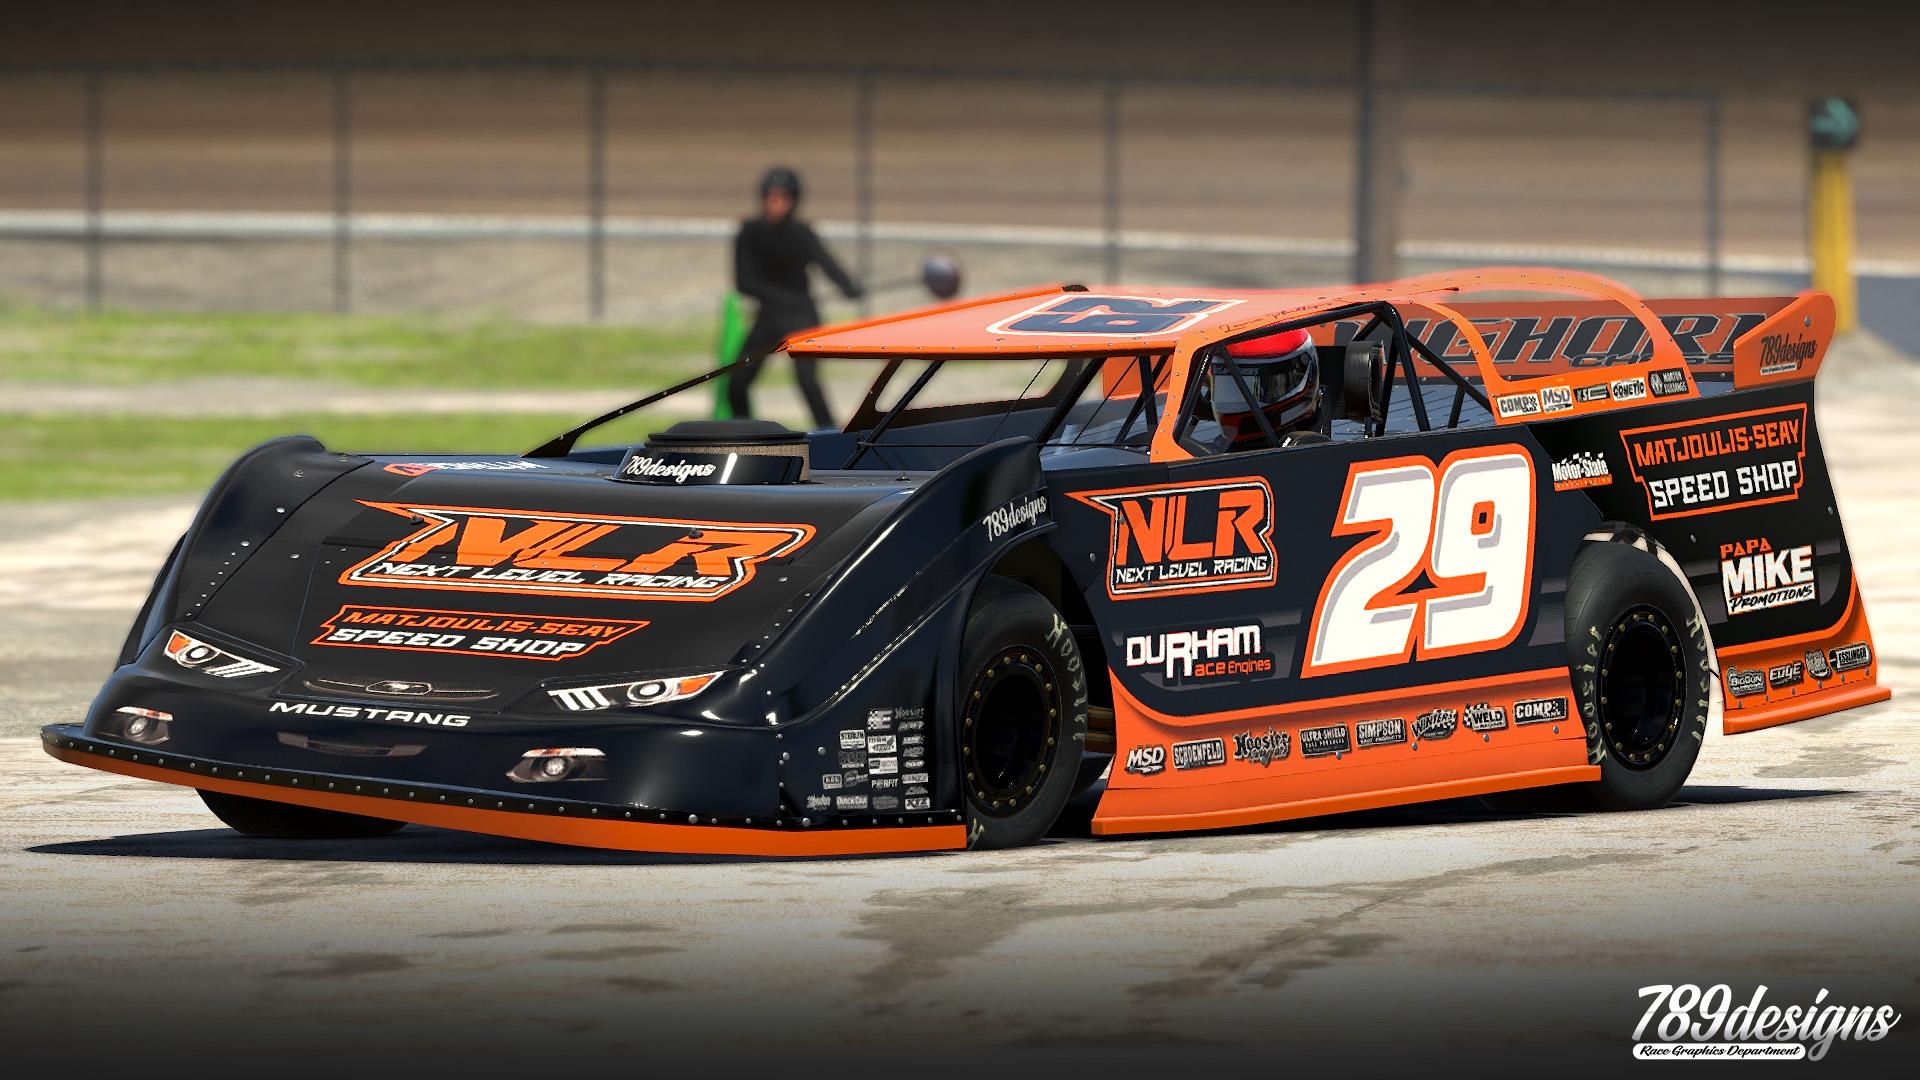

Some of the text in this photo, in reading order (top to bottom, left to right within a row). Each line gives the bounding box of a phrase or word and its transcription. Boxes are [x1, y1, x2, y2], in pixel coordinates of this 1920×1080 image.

[1760, 332, 1817, 370] 789designs
[1499, 396, 1529, 413] COMP
[1542, 388, 1571, 406] MSD
[1633, 419, 1799, 467] MATJOULIS-SEAY
[622, 455, 717, 483] 789designs
[1648, 459, 1799, 508] SPEED SHOP
[982, 496, 1048, 542] 789designs
[1115, 489, 1266, 566] NLR
[388, 516, 798, 576] NLR
[1719, 537, 1773, 560] PAPA
[1115, 555, 1269, 584] NEXT LEVEL RACING
[1306, 448, 1534, 674] 29
[1721, 545, 1815, 598] MIKE
[373, 562, 735, 590] NEXT LEVEL RACING
[341, 611, 627, 638] MATJOULIS-SEAY
[327, 628, 588, 656] SPEED SHOP
[1126, 625, 1262, 679] DURHAM
[1228, 658, 1272, 675] Engines
[268, 702, 472, 728] MUSTANG
[1472, 710, 1503, 724] WELD
[1515, 701, 1553, 719] COMP
[1301, 727, 1346, 743] ULTRA SHIELD
[1358, 719, 1401, 739] SIMPSON
[1127, 746, 1165, 768] MSD
[1173, 742, 1222, 765] SCHOENFELD
